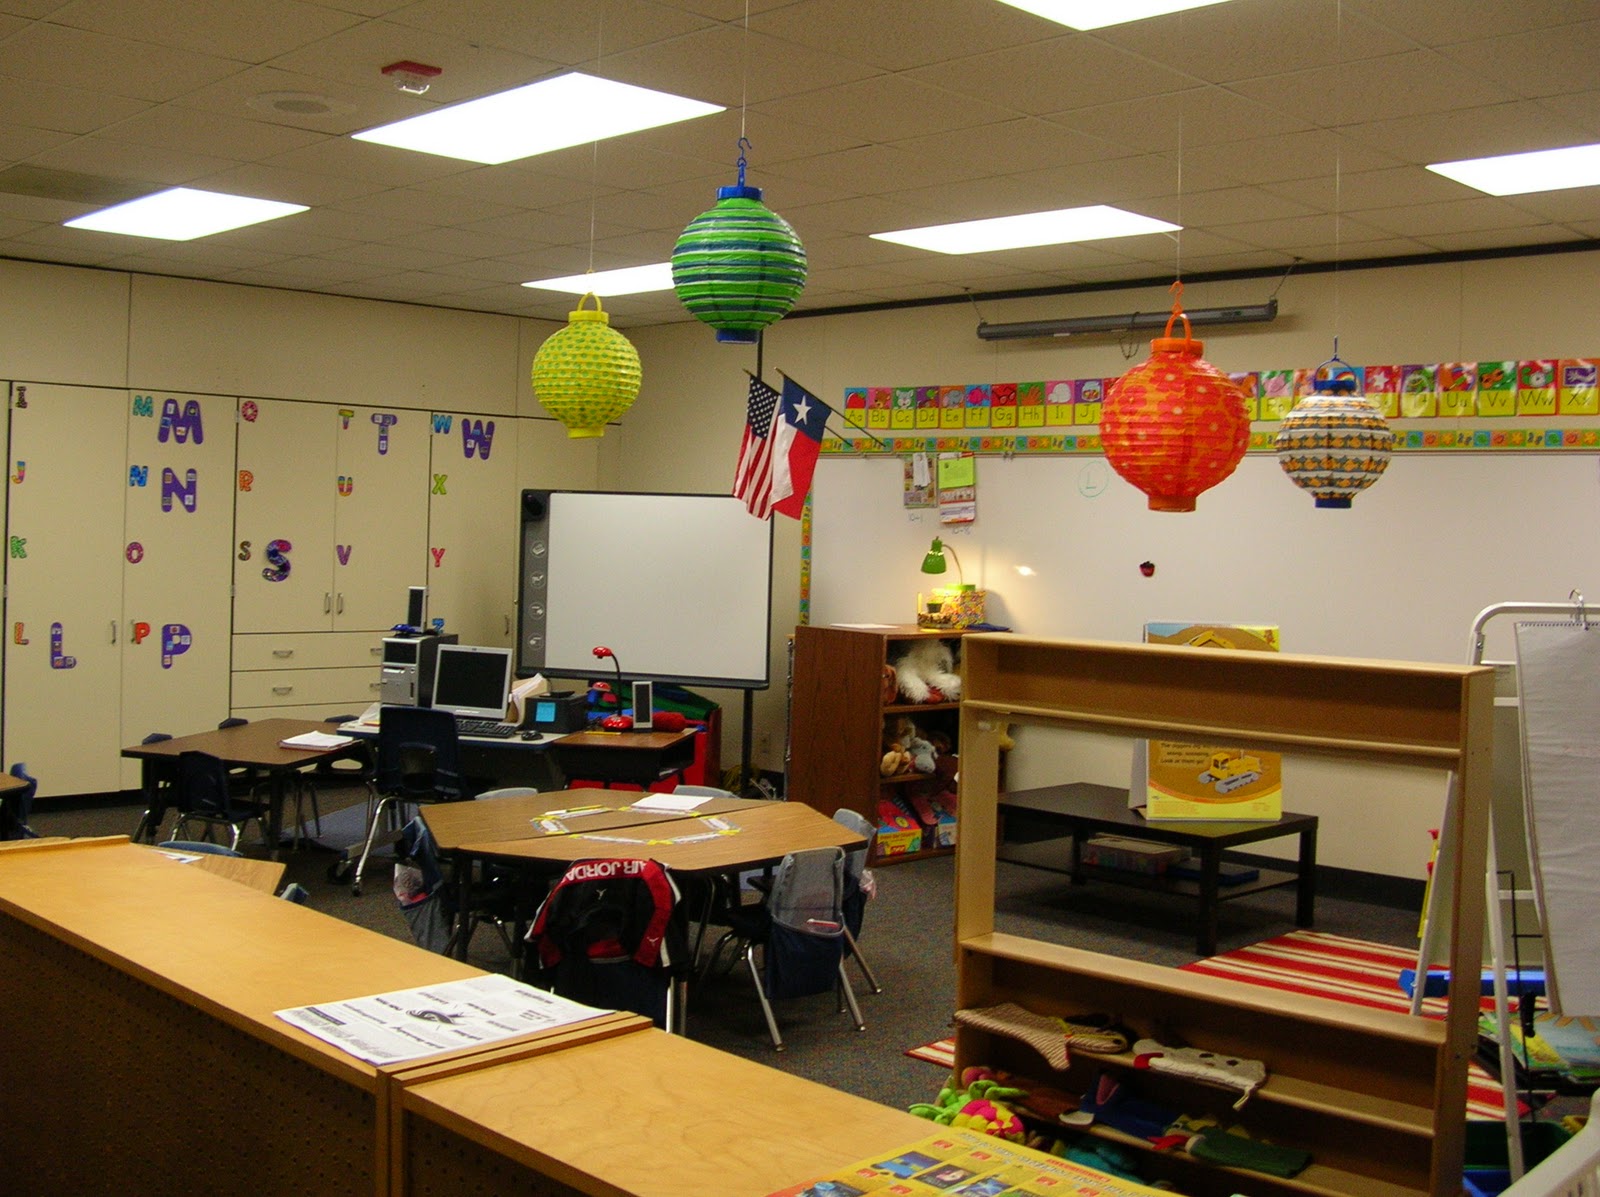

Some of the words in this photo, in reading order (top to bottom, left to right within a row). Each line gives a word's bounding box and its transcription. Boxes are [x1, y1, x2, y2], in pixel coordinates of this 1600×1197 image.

[16, 386, 28, 409] I
[848, 410, 863, 421] Aa
[871, 410, 886, 422] Bb
[895, 410, 909, 422] Cc
[919, 410, 935, 422] Dd
[945, 409, 959, 422] Ee
[970, 407, 984, 421] Ff
[994, 407, 1012, 426] Gg
[1022, 408, 1040, 420] Hh
[1055, 405, 1064, 419] Ii
[1079, 403, 1095, 424] Jj
[1446, 392, 1468, 408] Uu
[1486, 392, 1507, 407] Vv
[1520, 390, 1554, 406] Ww
[132, 395, 154, 418] M
[157, 398, 204, 445] M
[241, 400, 258, 423] Q
[338, 409, 354, 430] T
[371, 413, 398, 455] T
[433, 414, 452, 434] W
[461, 418, 495, 460] W
[10, 461, 26, 485] J
[239, 470, 254, 492] R
[432, 474, 448, 495] X
[129, 465, 148, 487] N
[161, 467, 197, 513] N
[337, 476, 353, 497] U
[10, 535, 27, 559] K
[125, 542, 144, 564] O
[336, 545, 352, 566] V
[431, 548, 445, 568] Y
[238, 541, 251, 561] S
[262, 539, 292, 582] S
[14, 622, 29, 645] L
[50, 622, 77, 669] L
[135, 622, 150, 644] P
[161, 624, 192, 669] P
[561, 861, 621, 883] JORDA
[623, 860, 648, 875] AIR
